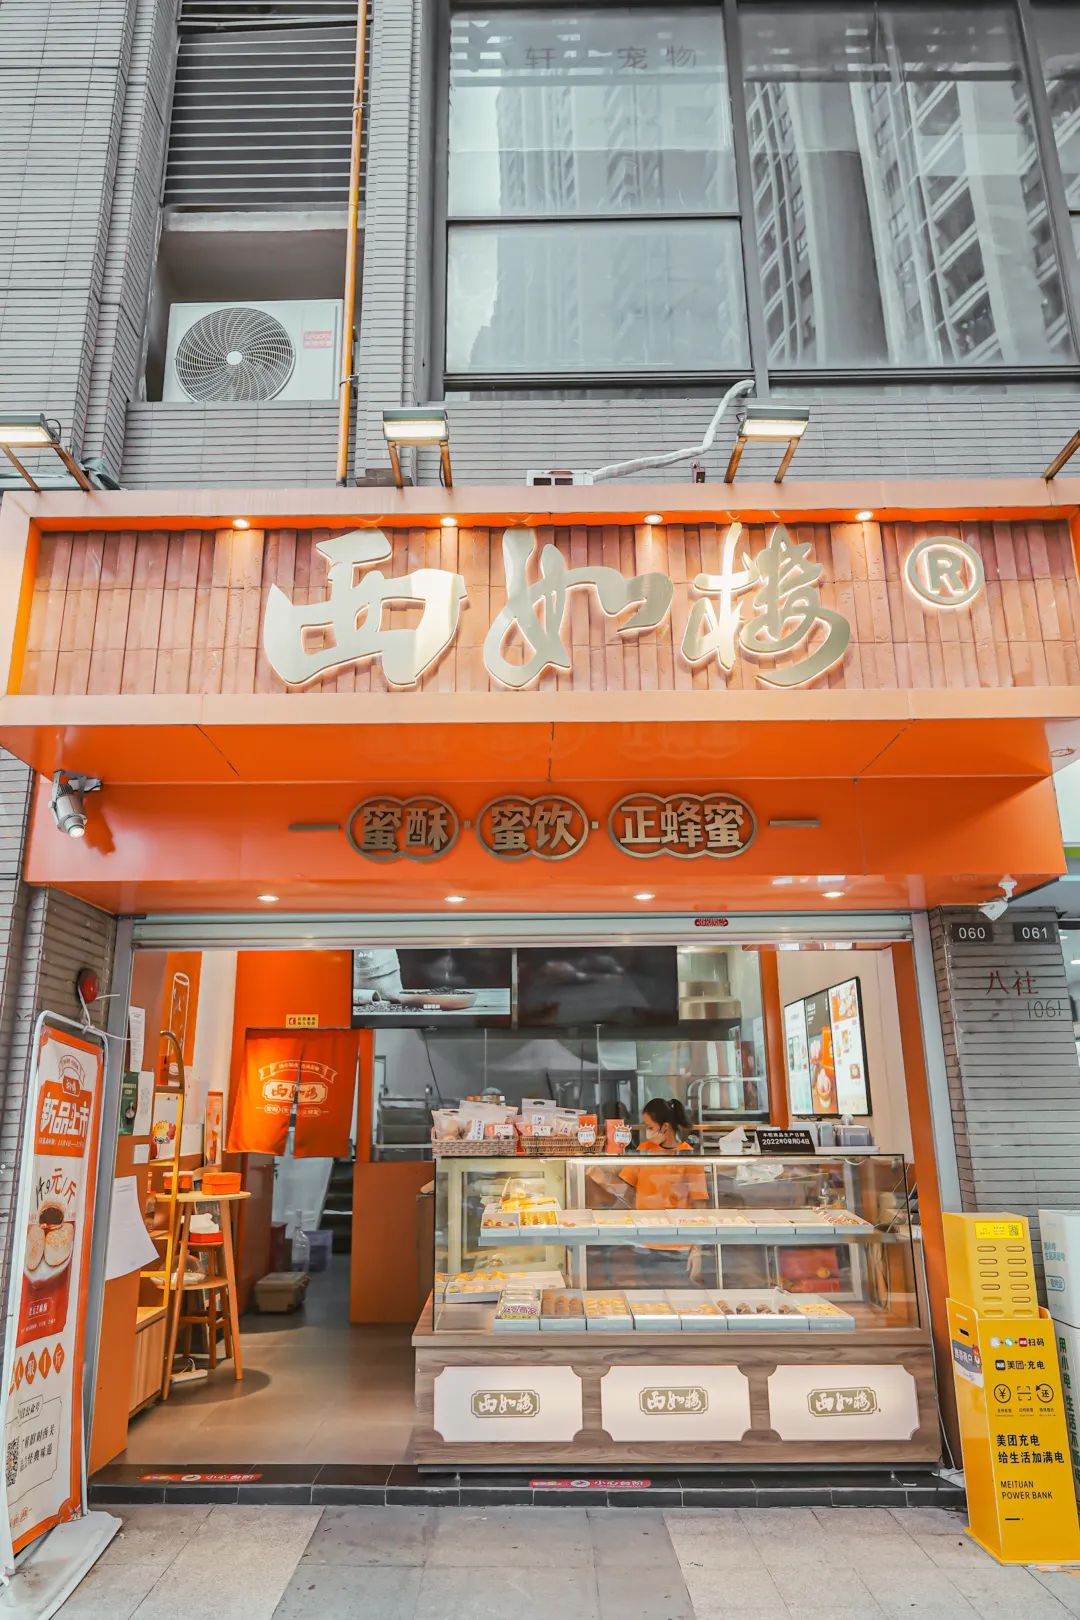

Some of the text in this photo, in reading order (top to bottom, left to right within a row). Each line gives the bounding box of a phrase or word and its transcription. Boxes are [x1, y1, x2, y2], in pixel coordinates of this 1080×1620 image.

[363, 801, 744, 852] 蜜酥 蜜饮 正蜂蜜
[958, 927, 986, 939] 060
[1022, 927, 1048, 939] 061
[986, 970, 1039, 996] 八社
[1027, 1000, 1061, 1019] 1061
[41, 1091, 89, 1138] 新品上市
[1028, 1338, 1045, 1347] 扫码
[996, 1434, 1040, 1446] 美团充电
[998, 1451, 1065, 1464] 给生活加满电
[1000, 1480, 1034, 1488] MEITUAN
[1002, 1491, 1053, 1499] POWER BANK
